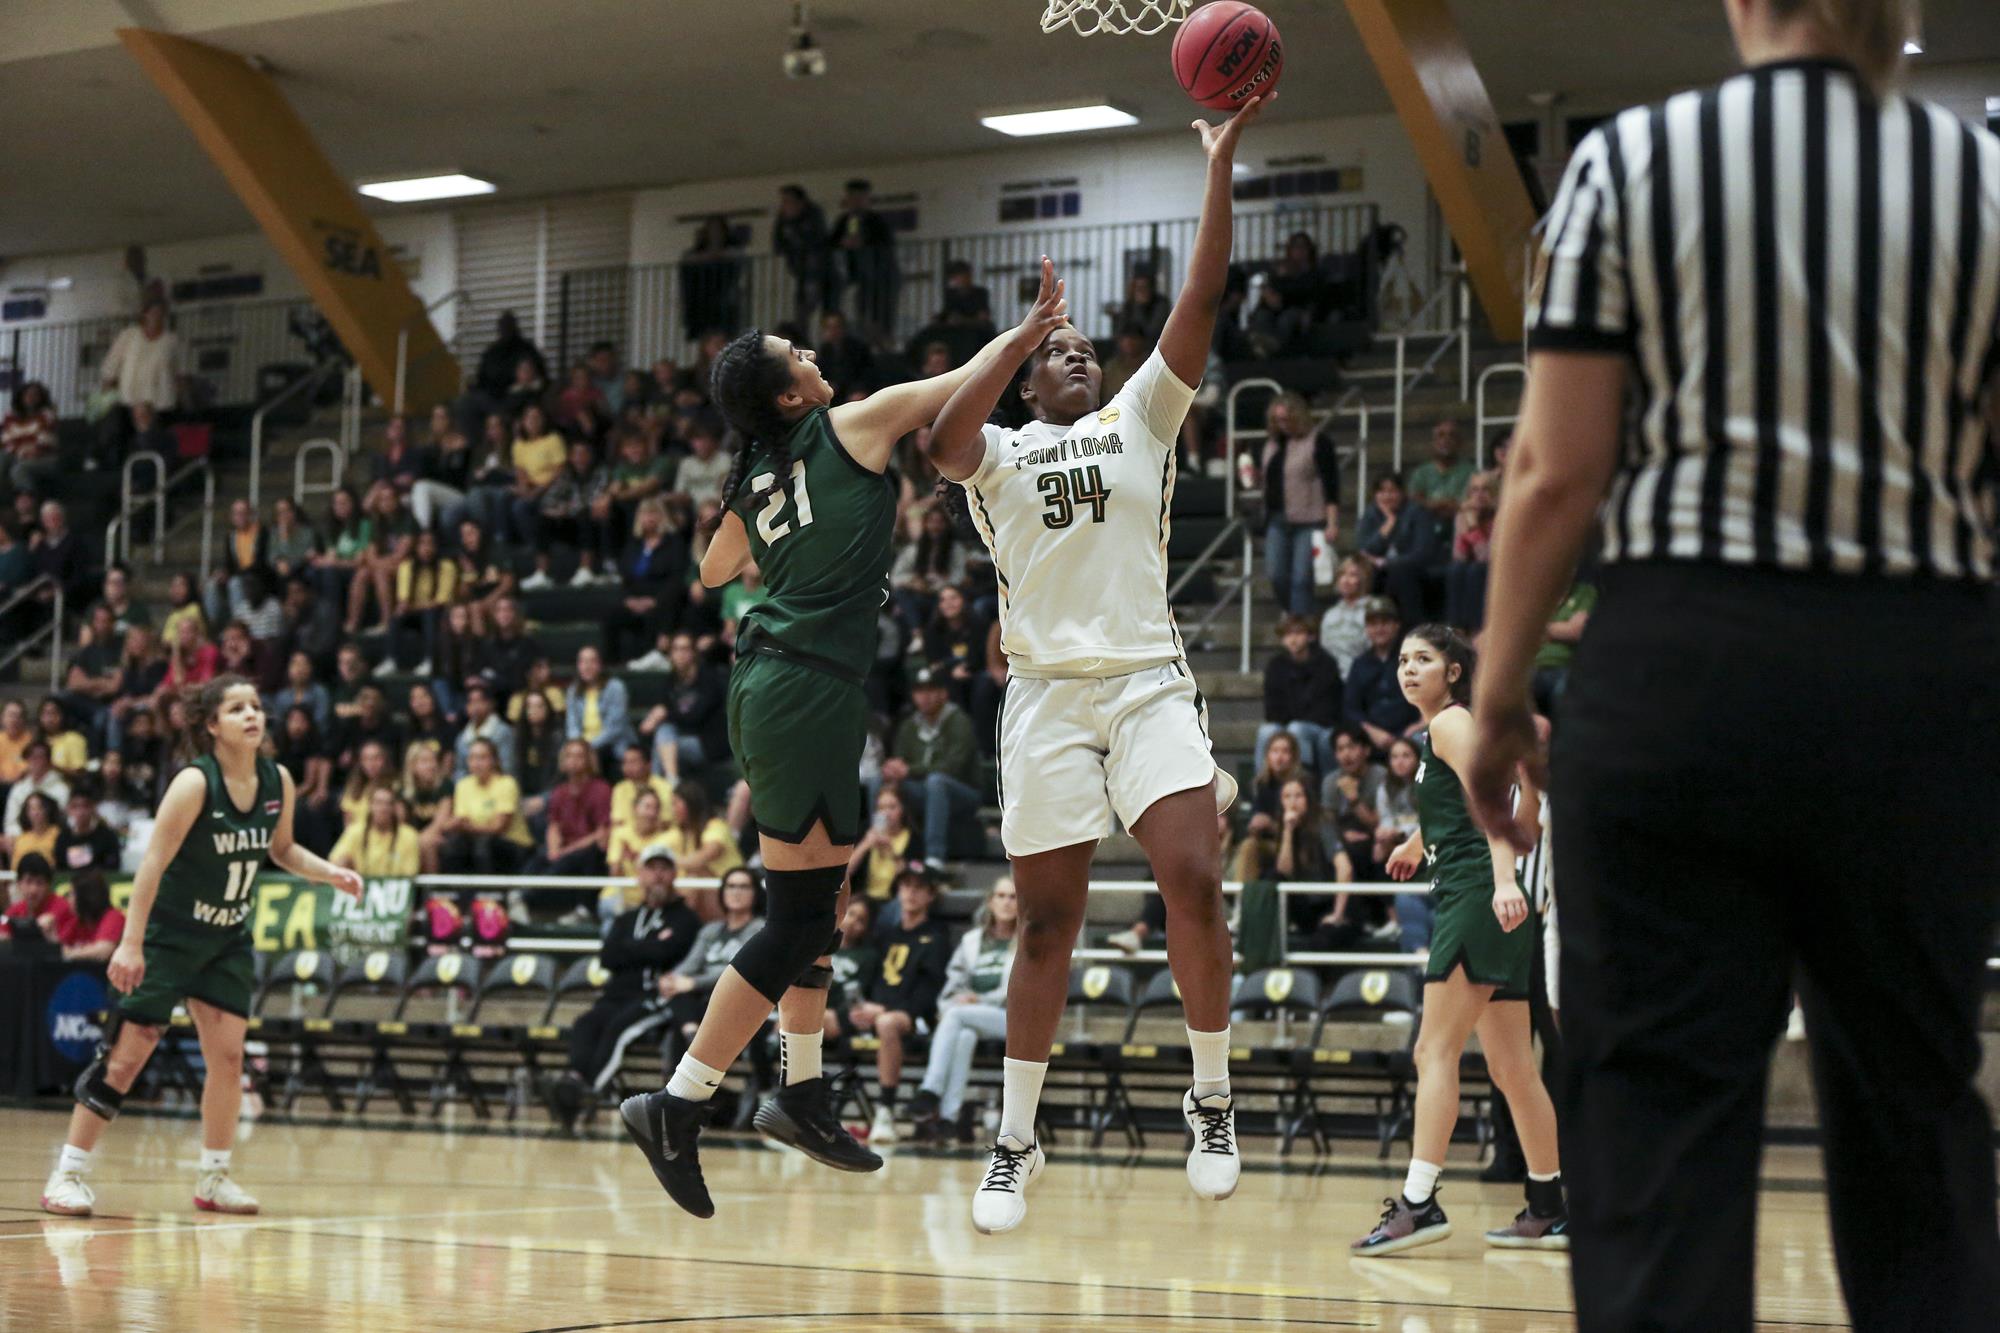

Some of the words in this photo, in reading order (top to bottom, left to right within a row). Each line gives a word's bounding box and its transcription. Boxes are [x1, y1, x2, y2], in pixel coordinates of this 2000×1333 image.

[1216, 27, 1259, 77] NCAA
[1071, 433, 1123, 459] LOMA
[751, 458, 814, 548] 21
[1037, 465, 1112, 530] 34
[212, 827, 271, 855] WALL
[193, 900, 251, 927] WAL
